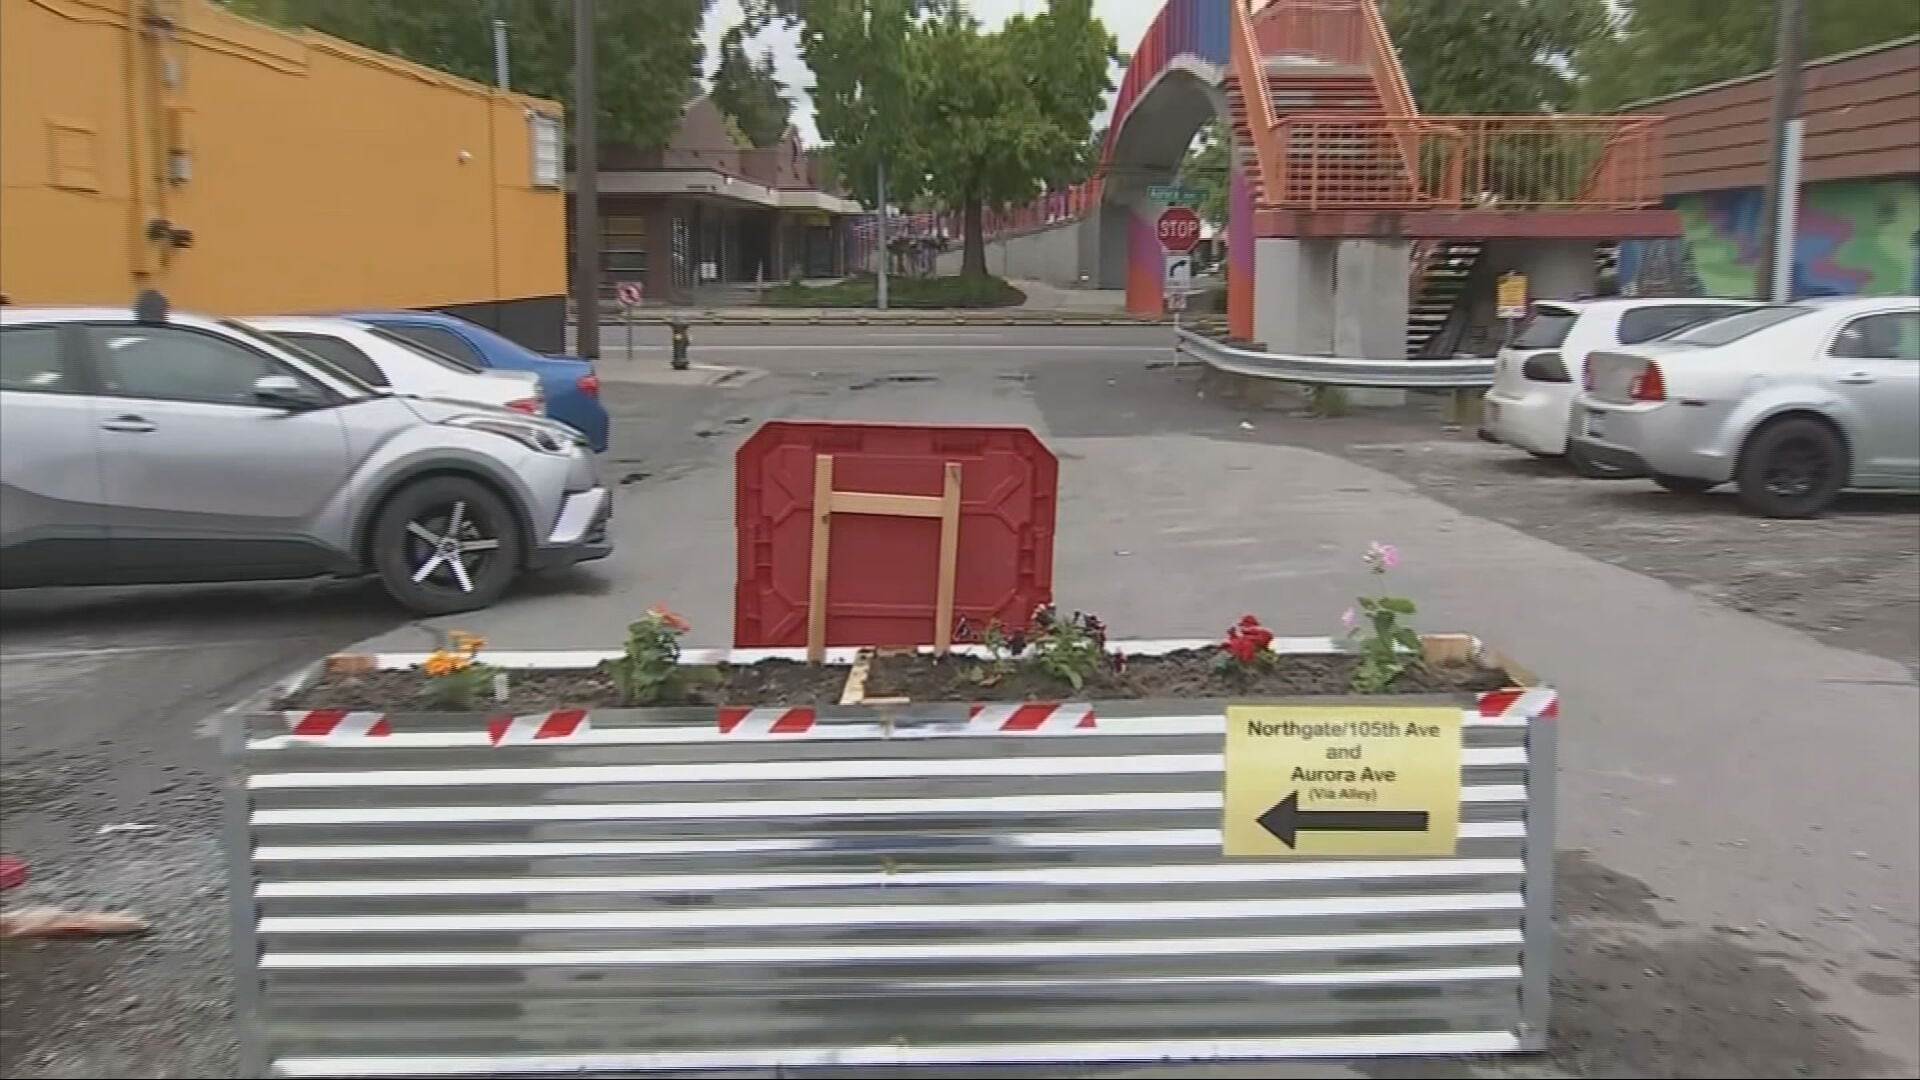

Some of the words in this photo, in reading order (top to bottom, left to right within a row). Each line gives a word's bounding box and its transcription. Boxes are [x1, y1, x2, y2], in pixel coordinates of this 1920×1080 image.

[1159, 221, 1198, 237] STOP
[1247, 720, 1399, 739] Northgate/105th
[1404, 721, 1440, 738] Ave
[1325, 744, 1362, 760] and
[1291, 766, 1356, 782] Aurora
[1361, 767, 1397, 783] Ave
[1308, 788, 1337, 800] (Via
[1339, 788, 1377, 801] Alley)
